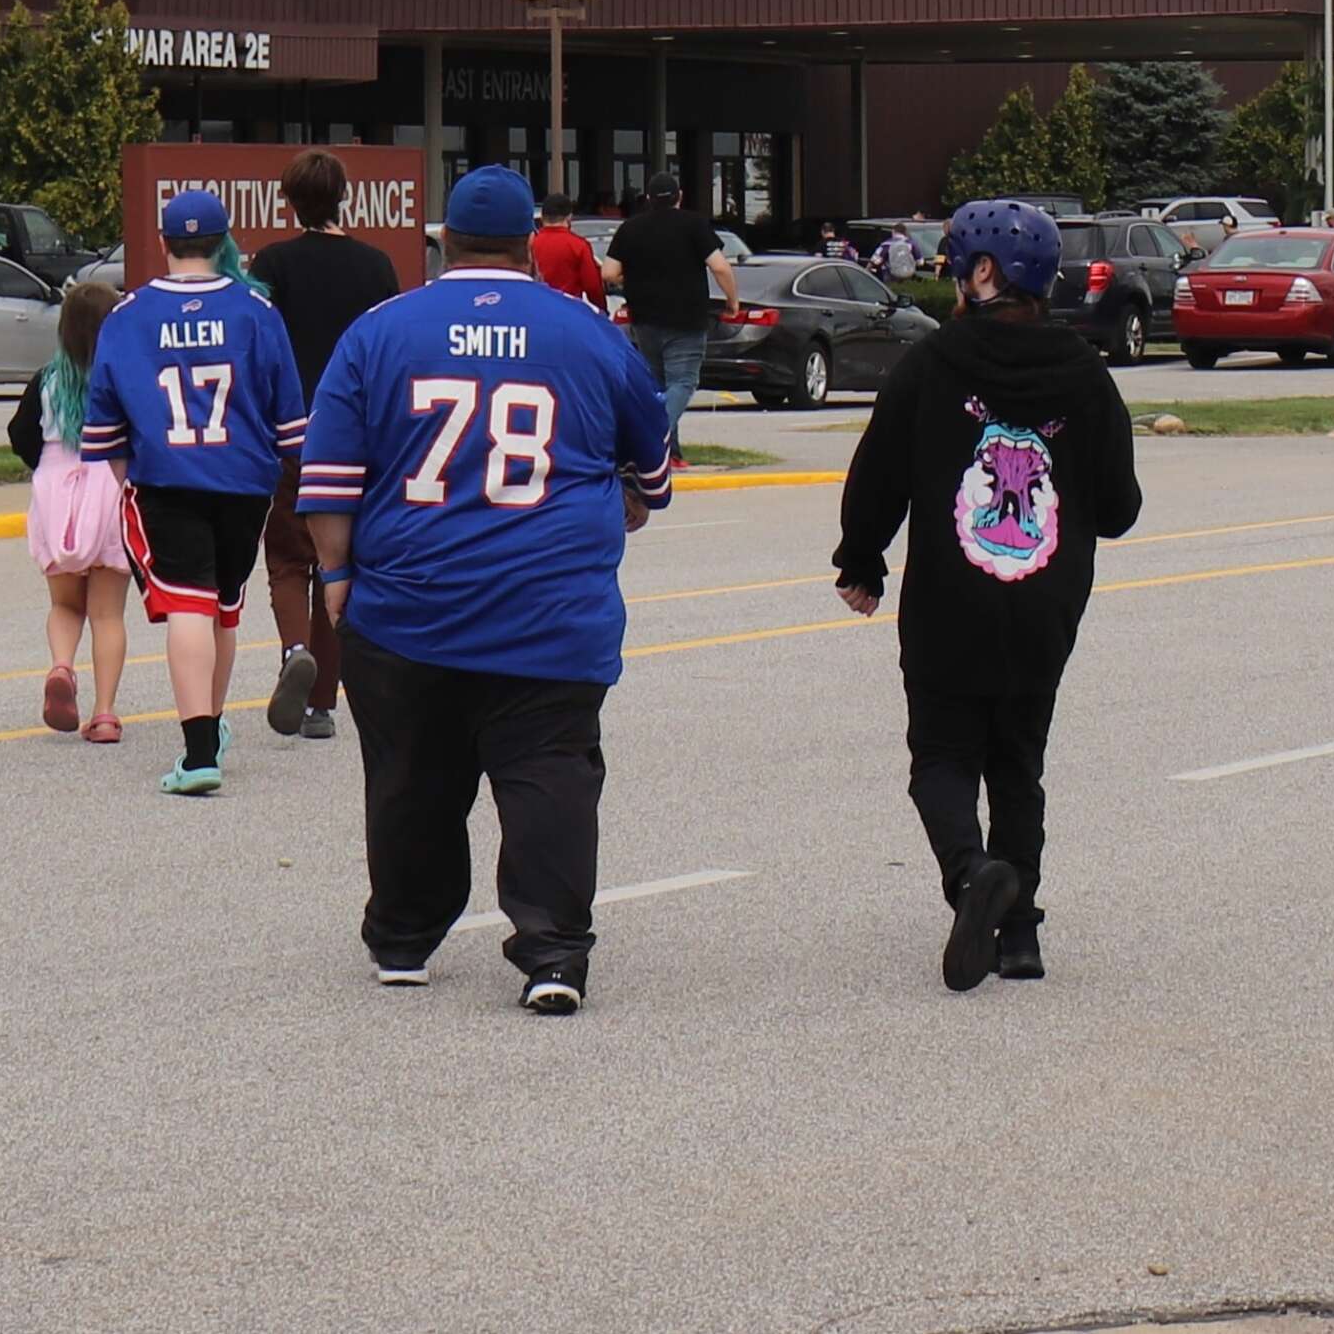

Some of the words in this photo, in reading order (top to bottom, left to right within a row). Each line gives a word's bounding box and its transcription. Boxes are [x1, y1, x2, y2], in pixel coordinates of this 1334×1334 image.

[180, 30, 237, 68] AREA
[245, 32, 270, 69] 2E
[441, 67, 475, 100] AST
[156, 179, 287, 228] EUTIVE
[293, 179, 416, 228] RANCE
[159, 320, 224, 349] ALLEN
[448, 324, 527, 358] SMITH
[157, 363, 233, 446] 17
[403, 377, 556, 508] 78
